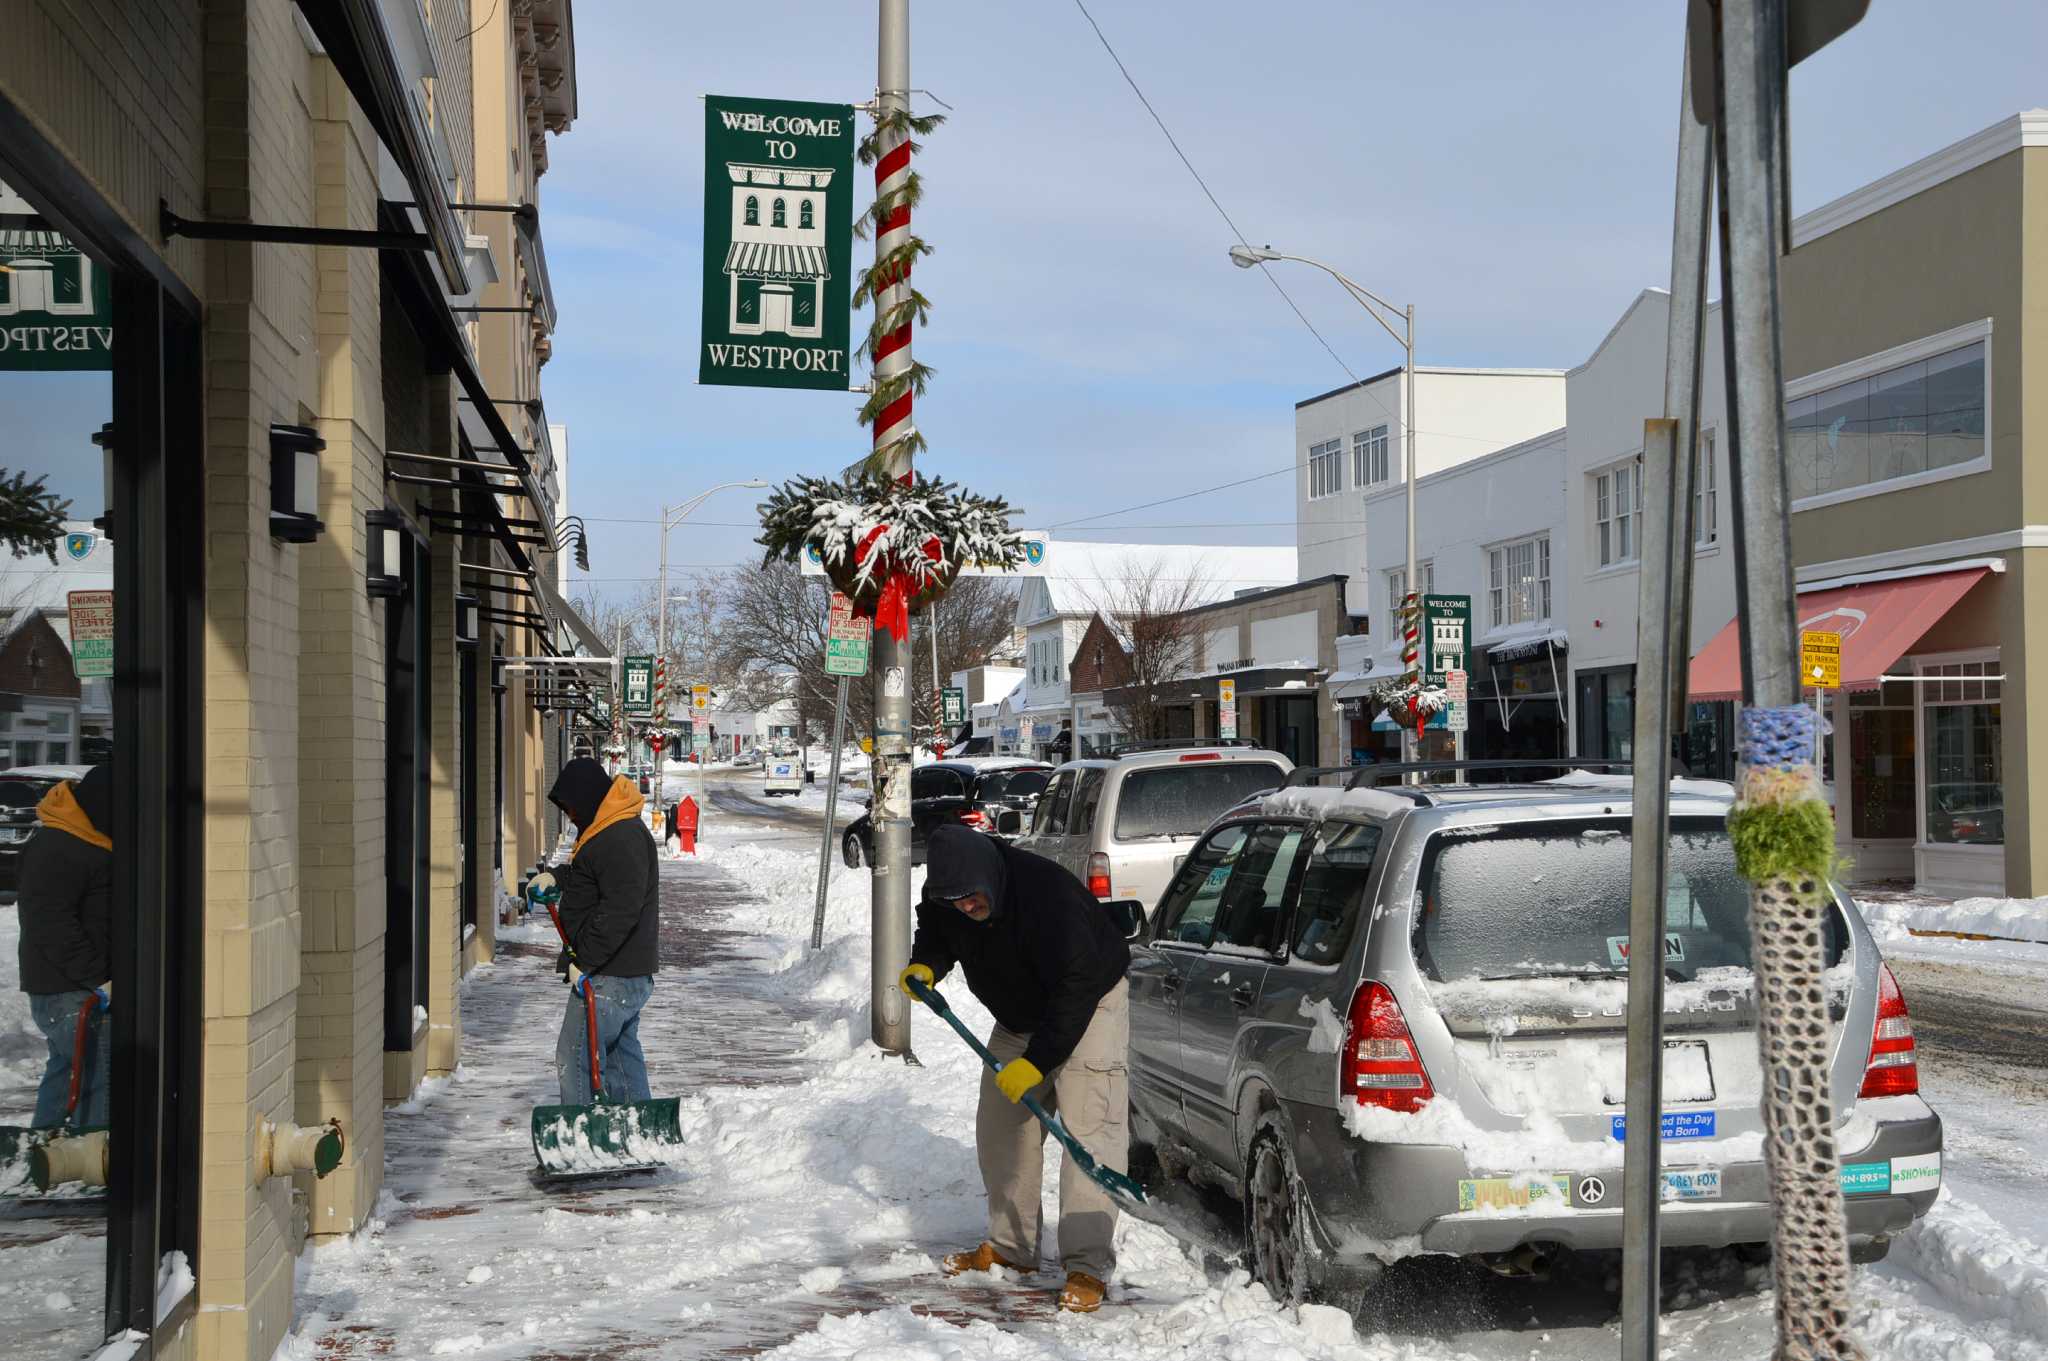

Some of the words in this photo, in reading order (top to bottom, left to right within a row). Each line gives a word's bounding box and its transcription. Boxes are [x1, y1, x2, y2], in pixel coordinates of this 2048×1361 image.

[720, 110, 841, 137] WELCOME
[765, 140, 797, 160] TO
[707, 343, 843, 372] WESTPORT
[832, 596, 844, 609] NO
[1428, 600, 1467, 609] WELCOME
[1443, 609, 1453, 617] TO
[843, 620, 865, 629] STREET
[1676, 1115, 1692, 1125] the
[1694, 1114, 1712, 1127] Day
[1675, 1127, 1699, 1137] Born
[1669, 1175, 1693, 1188] GREY
[1697, 1172, 1717, 1186] FOX
